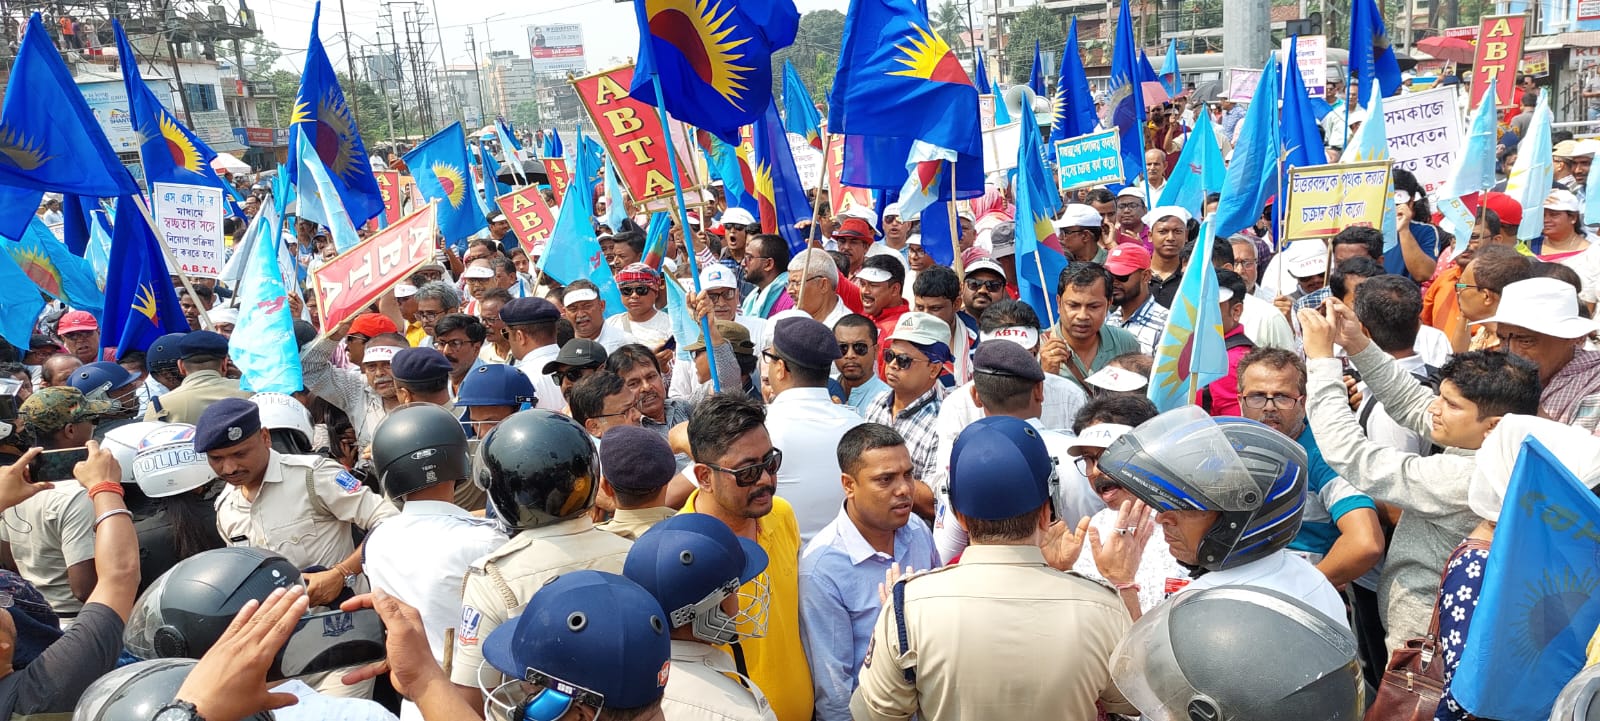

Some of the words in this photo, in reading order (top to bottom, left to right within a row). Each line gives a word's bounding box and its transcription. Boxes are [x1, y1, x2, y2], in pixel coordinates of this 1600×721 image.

[1384, 101, 1444, 125] সমকাজে
[595, 75, 677, 197] ABTA
[1387, 126, 1447, 150] সমবেতন
[1293, 174, 1339, 192] উত্তরবঙ্গকে
[1341, 172, 1363, 196] পৃথক
[995, 328, 1029, 339] ABTA
